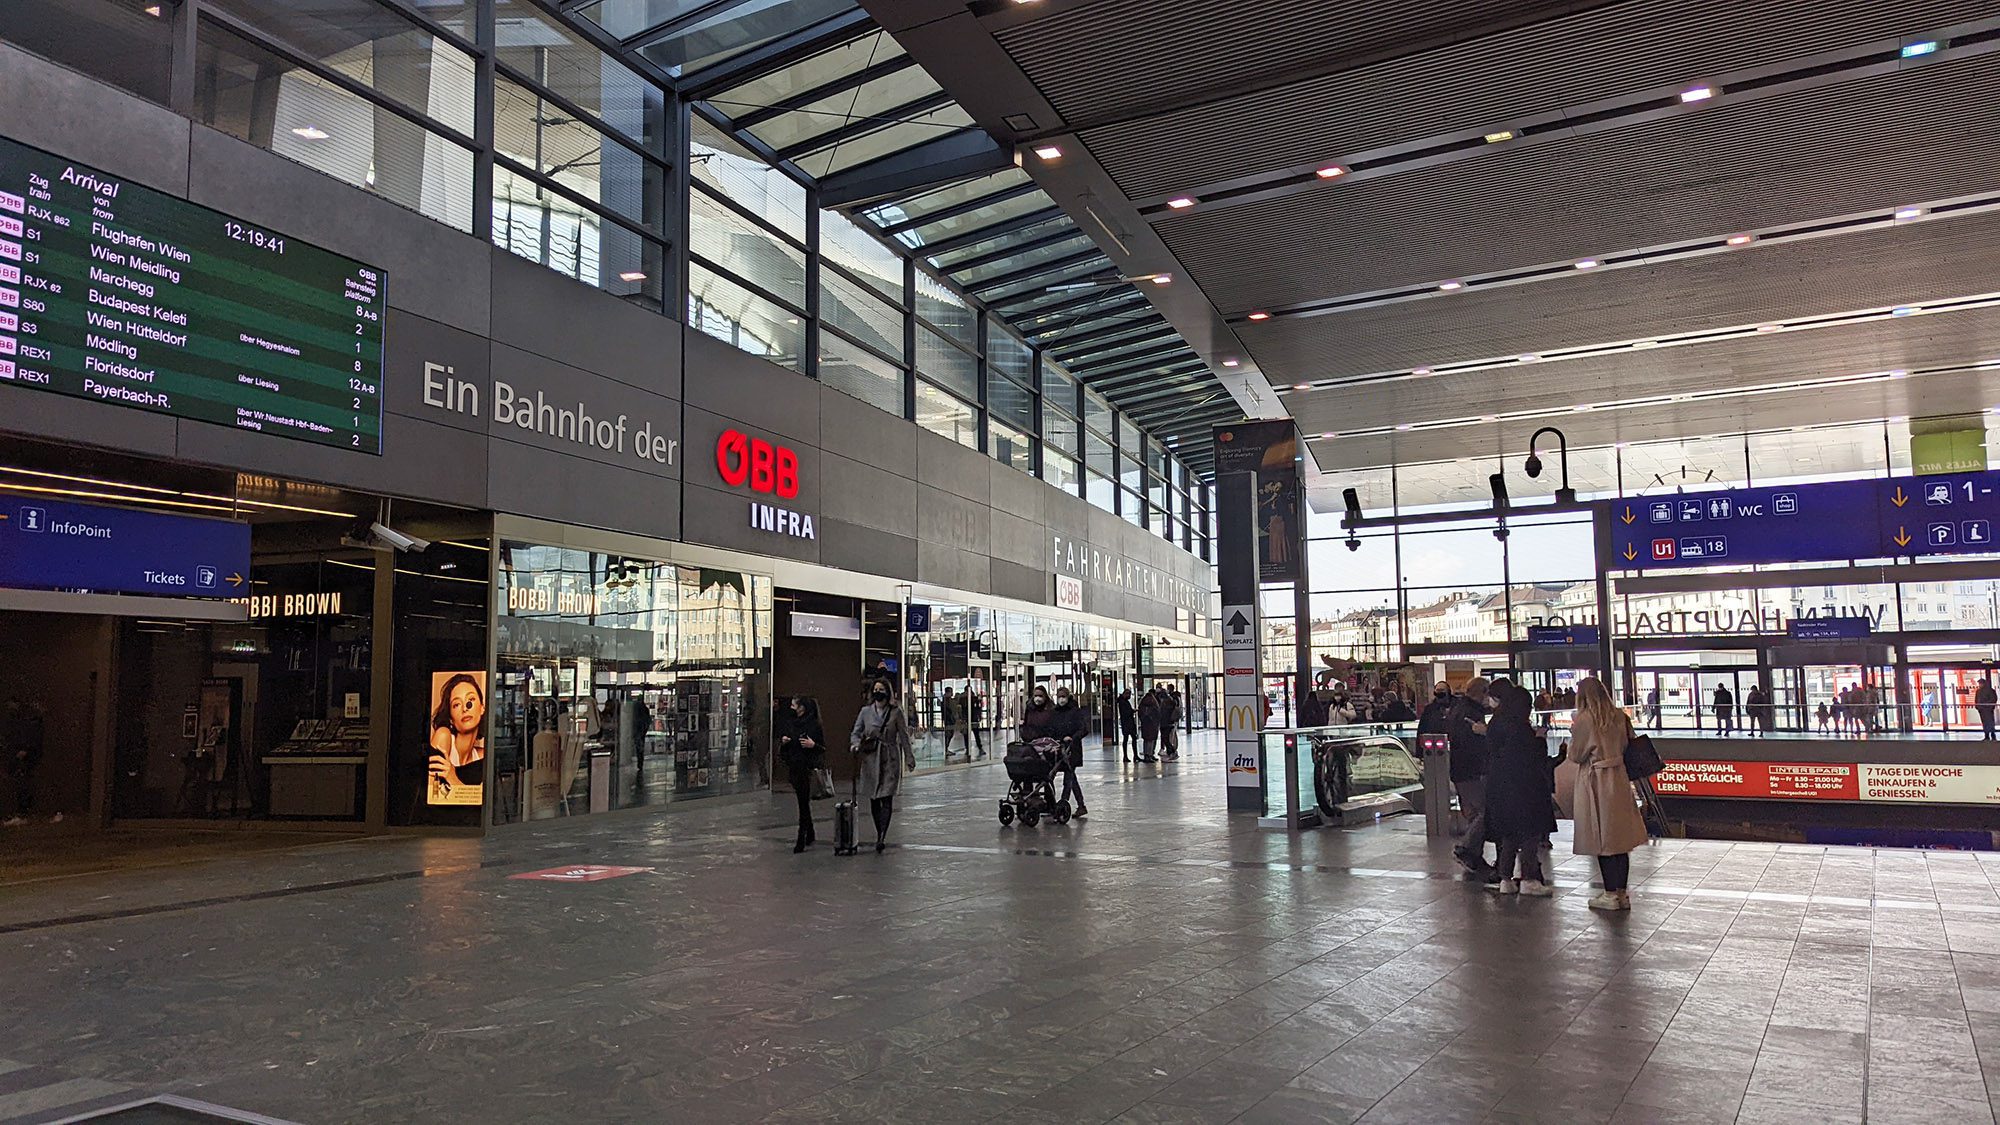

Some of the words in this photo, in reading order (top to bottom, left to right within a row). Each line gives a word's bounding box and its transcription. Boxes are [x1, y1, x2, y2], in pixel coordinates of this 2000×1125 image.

[29, 173, 49, 189] Zug
[60, 166, 119, 198] Arrival
[29, 186, 52, 201] train
[93, 195, 110, 208] von
[92, 206, 114, 221] from
[224, 221, 285, 254] 12:19:41
[27, 205, 51, 222] RJX
[53, 215, 71, 227] 862
[92, 222, 156, 253] Flughafen
[158, 241, 192, 263] Wien
[355, 305, 363, 317] 8
[364, 311, 378, 322] A-B
[26, 228, 41, 241] S1
[90, 243, 126, 266] Wien
[129, 255, 180, 284] Meidling
[355, 323, 363, 335] 2
[345, 278, 376, 297] Bahnsteig
[25, 252, 40, 264] S1
[89, 266, 154, 298] Marchegg
[355, 342, 361, 353] 1
[345, 290, 372, 304] platform
[24, 274, 48, 290] RJX
[50, 283, 62, 293] 62
[88, 288, 151, 317] Budapest
[153, 306, 187, 326] Keleti
[354, 360, 362, 372] 8
[23, 298, 45, 313] S80
[87, 310, 122, 332] Wien
[126, 320, 187, 347] Hütteldorf
[348, 377, 361, 391] 12
[361, 384, 376, 394] A-B
[21, 322, 37, 334] S3
[86, 333, 137, 360] Mödling
[238, 373, 254, 385] über
[255, 377, 280, 392] Liesing
[353, 397, 361, 409] 2
[20, 344, 51, 361] REX1
[85, 356, 155, 383] Floridsdorf
[353, 416, 359, 428] 1
[19, 368, 50, 384] REX1
[84, 378, 171, 409] Payerbach-R.
[352, 434, 360, 446] 2
[422, 360, 480, 417] Ein
[493, 381, 628, 454] Bahnhof
[634, 421, 678, 466] der
[236, 417, 262, 431] Liesing
[1962, 481, 1974, 502] 1
[1737, 504, 1764, 517] WC
[51, 520, 112, 539] InfoPoint
[751, 501, 816, 541] INFRA
[1655, 543, 1672, 555] U1
[1707, 541, 1724, 552] 18
[143, 570, 186, 586] Tickets
[1053, 536, 1158, 598] FAHRKARTEN
[1168, 578, 1207, 613] TICKETS
[284, 592, 341, 616] BROWN
[508, 586, 553, 612] BOBBI
[557, 592, 602, 616] BROWN
[1233, 753, 1255, 767] dm
[1657, 772, 1676, 782] FÜR
[1676, 773, 1696, 782] DAS
[1697, 773, 1744, 784] TÄGLICHE
[1867, 767, 1873, 776] 7
[1875, 768, 1902, 777] TAGE
[1903, 768, 1920, 777] DIE
[1921, 768, 1963, 777] WOCHE
[1657, 783, 1689, 792] LEBEN.
[1867, 778, 1927, 787] EINKAUFEN
[1928, 779, 1937, 788] &
[1868, 788, 1929, 799] GENIESSEN.
